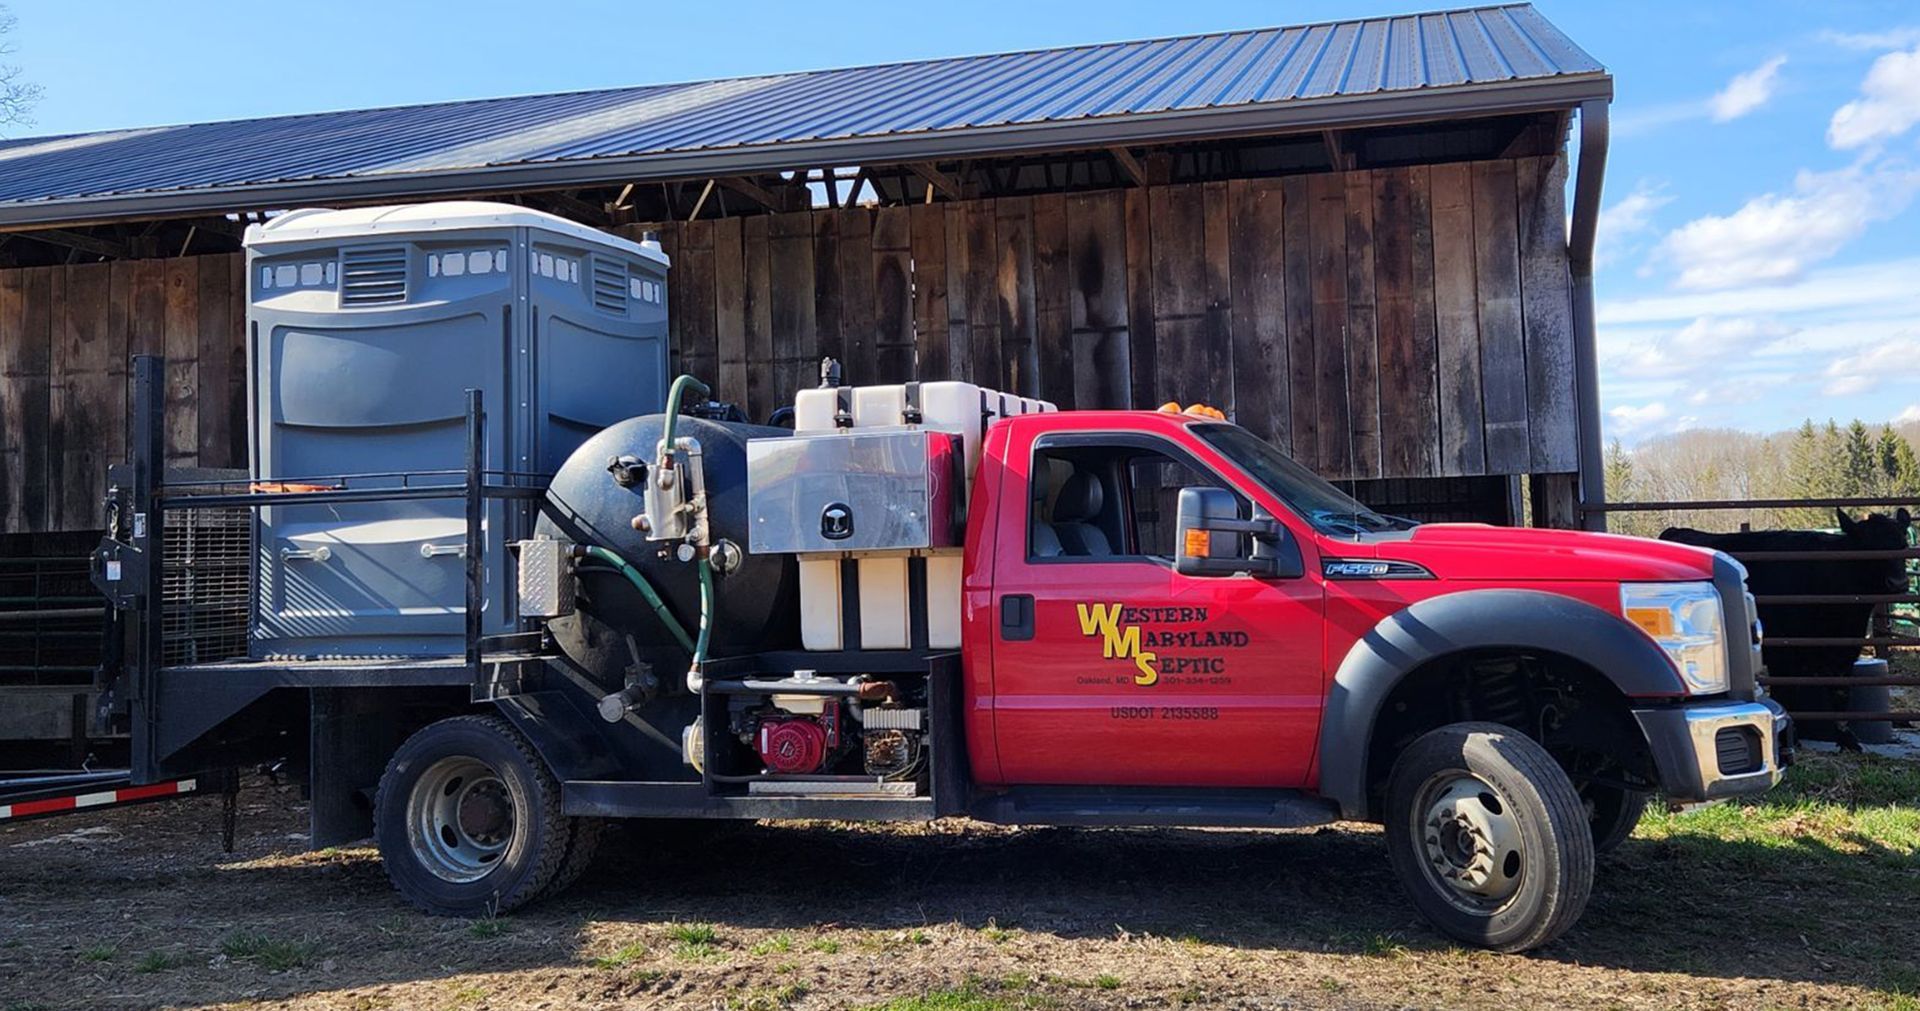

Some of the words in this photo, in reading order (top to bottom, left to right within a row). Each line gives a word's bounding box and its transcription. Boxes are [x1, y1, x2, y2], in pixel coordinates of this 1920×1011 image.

[1076, 603, 1208, 636] WESTERN
[1103, 626, 1249, 659] MARYLAND
[1115, 676, 1129, 685] MD
[1134, 652, 1225, 686] SEPTIC
[1111, 706, 1154, 719] USDOT
[1161, 706, 1219, 720] 2135588
